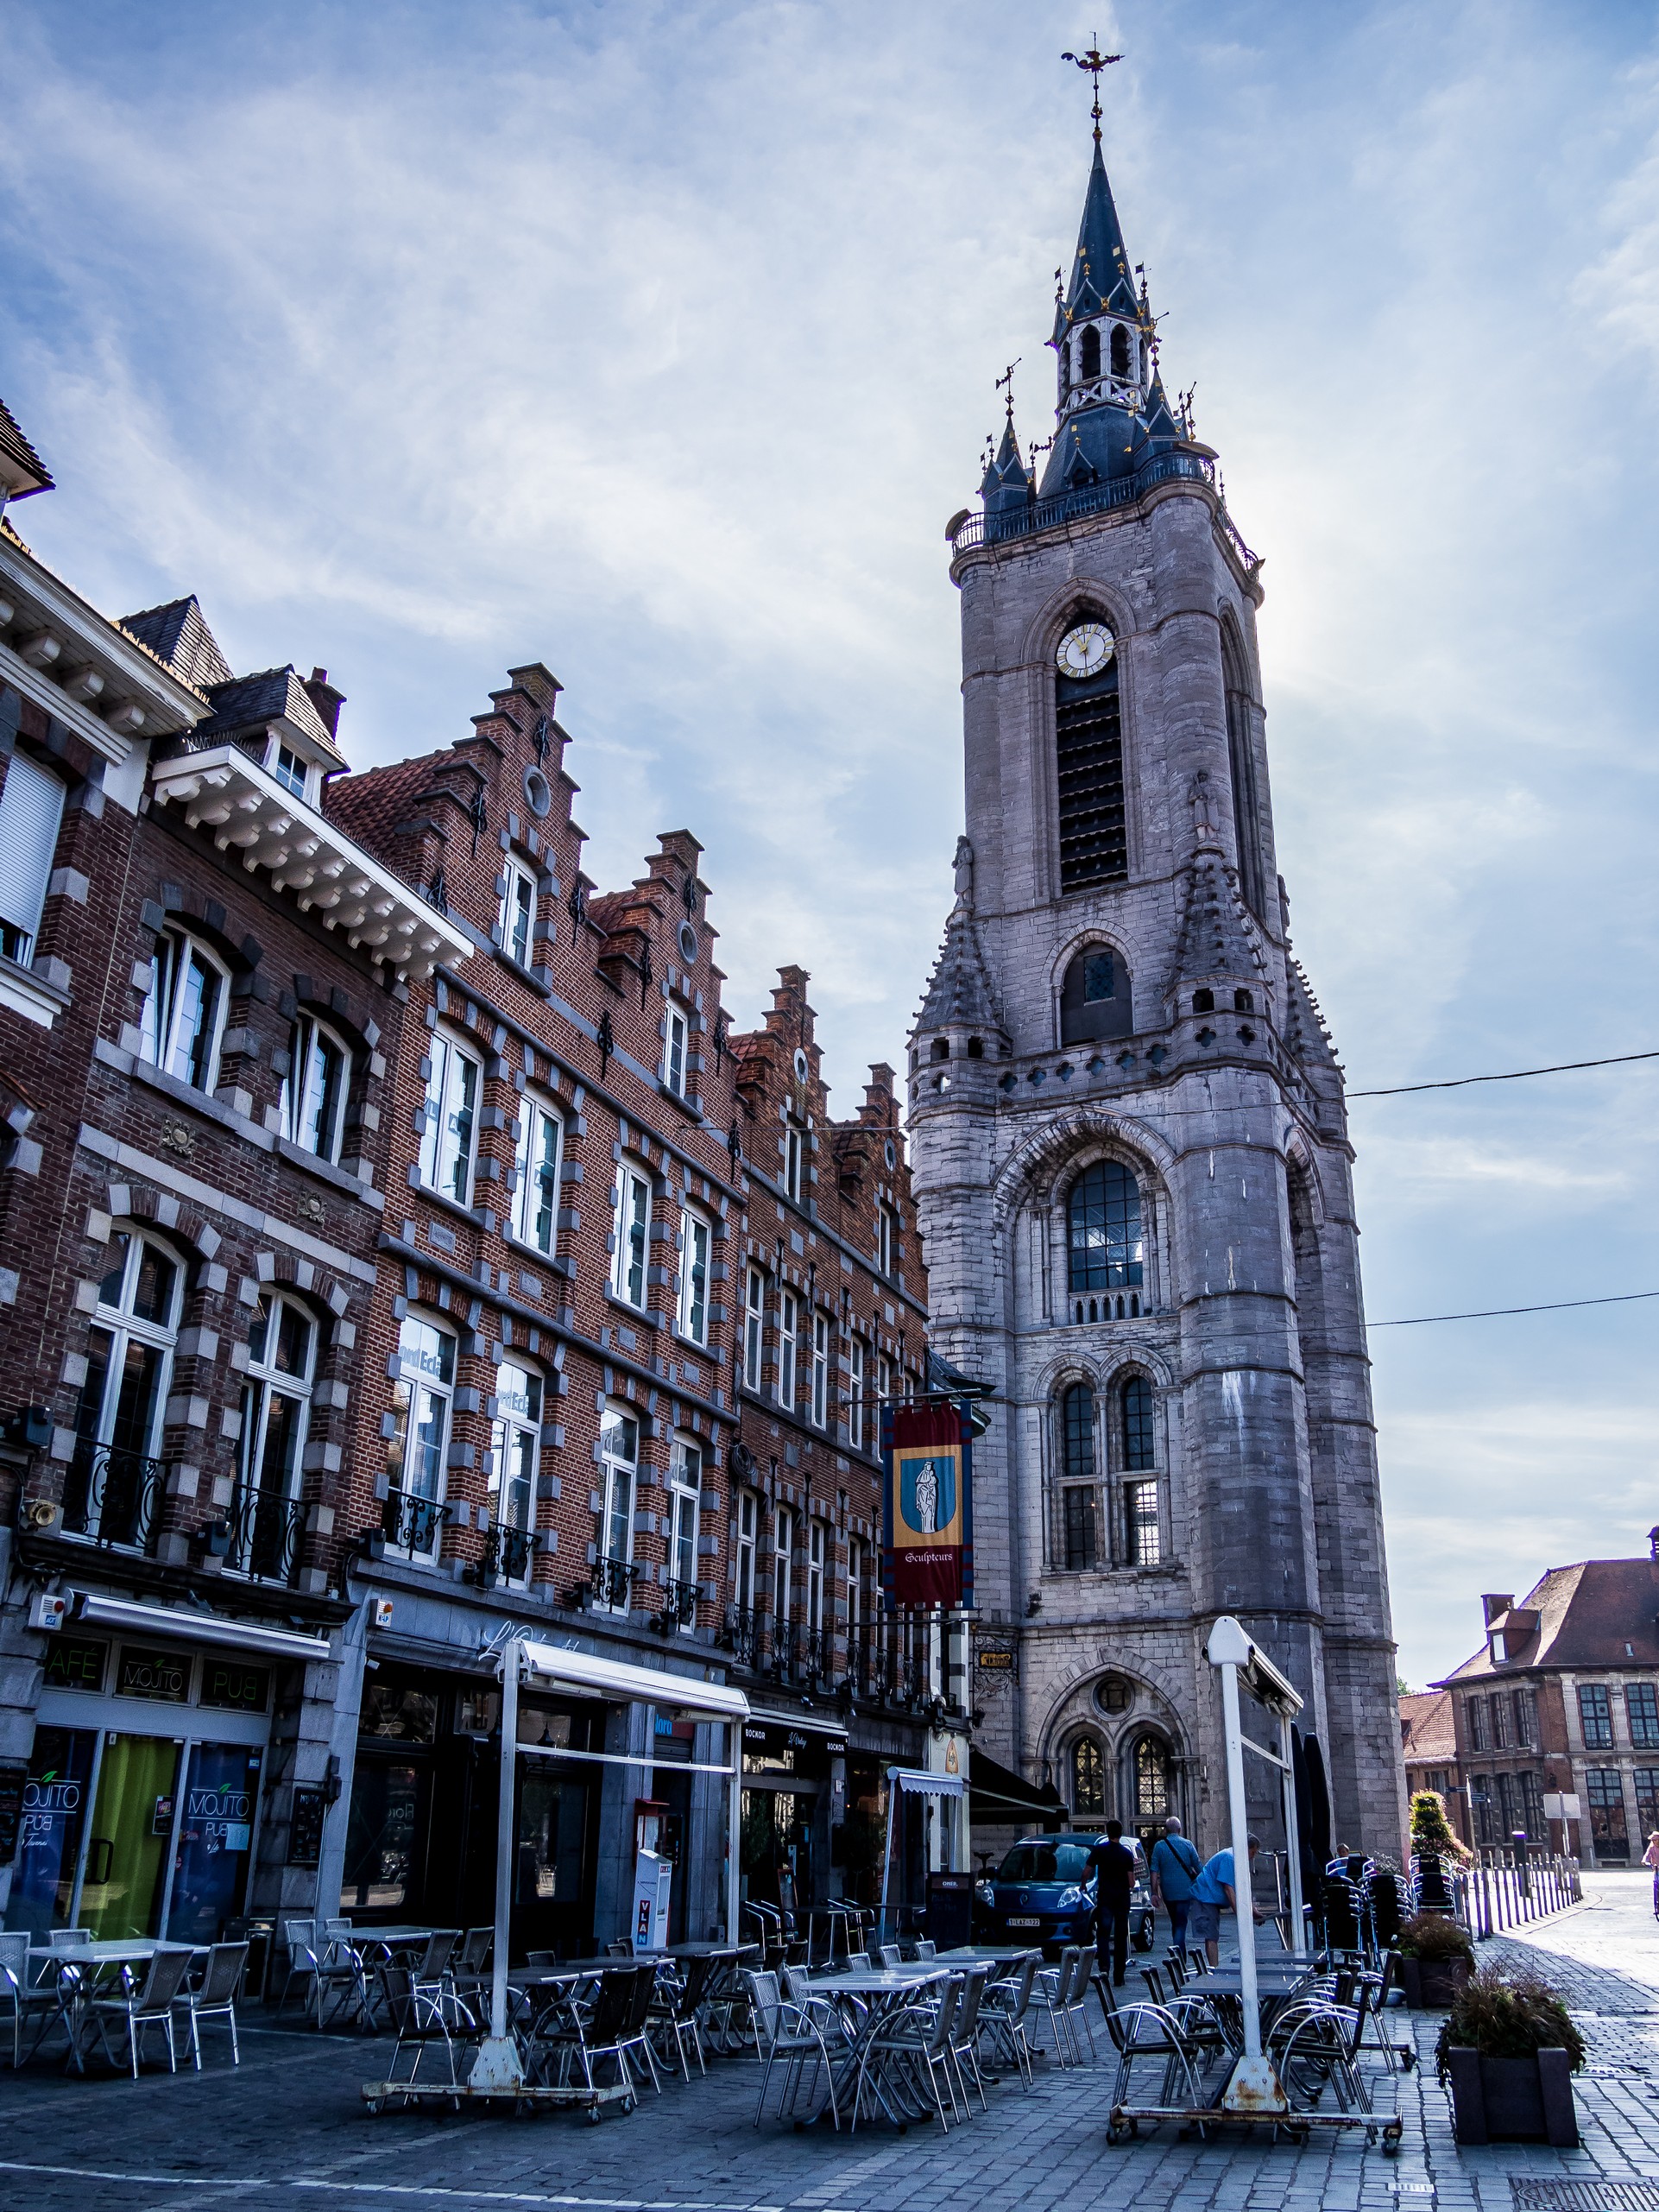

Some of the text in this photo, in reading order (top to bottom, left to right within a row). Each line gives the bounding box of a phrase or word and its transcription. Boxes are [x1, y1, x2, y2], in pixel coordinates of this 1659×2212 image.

[905, 1551, 953, 1564] Sculpteurs
[47, 1646, 98, 1679] AFÉ
[123, 1665, 183, 1692] MOJITO
[212, 1671, 257, 1701] PUB
[745, 1728, 766, 1741] BOCKOR
[826, 1742, 845, 1752] BOCKOR
[23, 1783, 79, 1809] OJITO
[188, 1793, 249, 1817] MOJITO
[23, 1814, 53, 1830] PUB
[638, 1901, 650, 1944] VLAN
